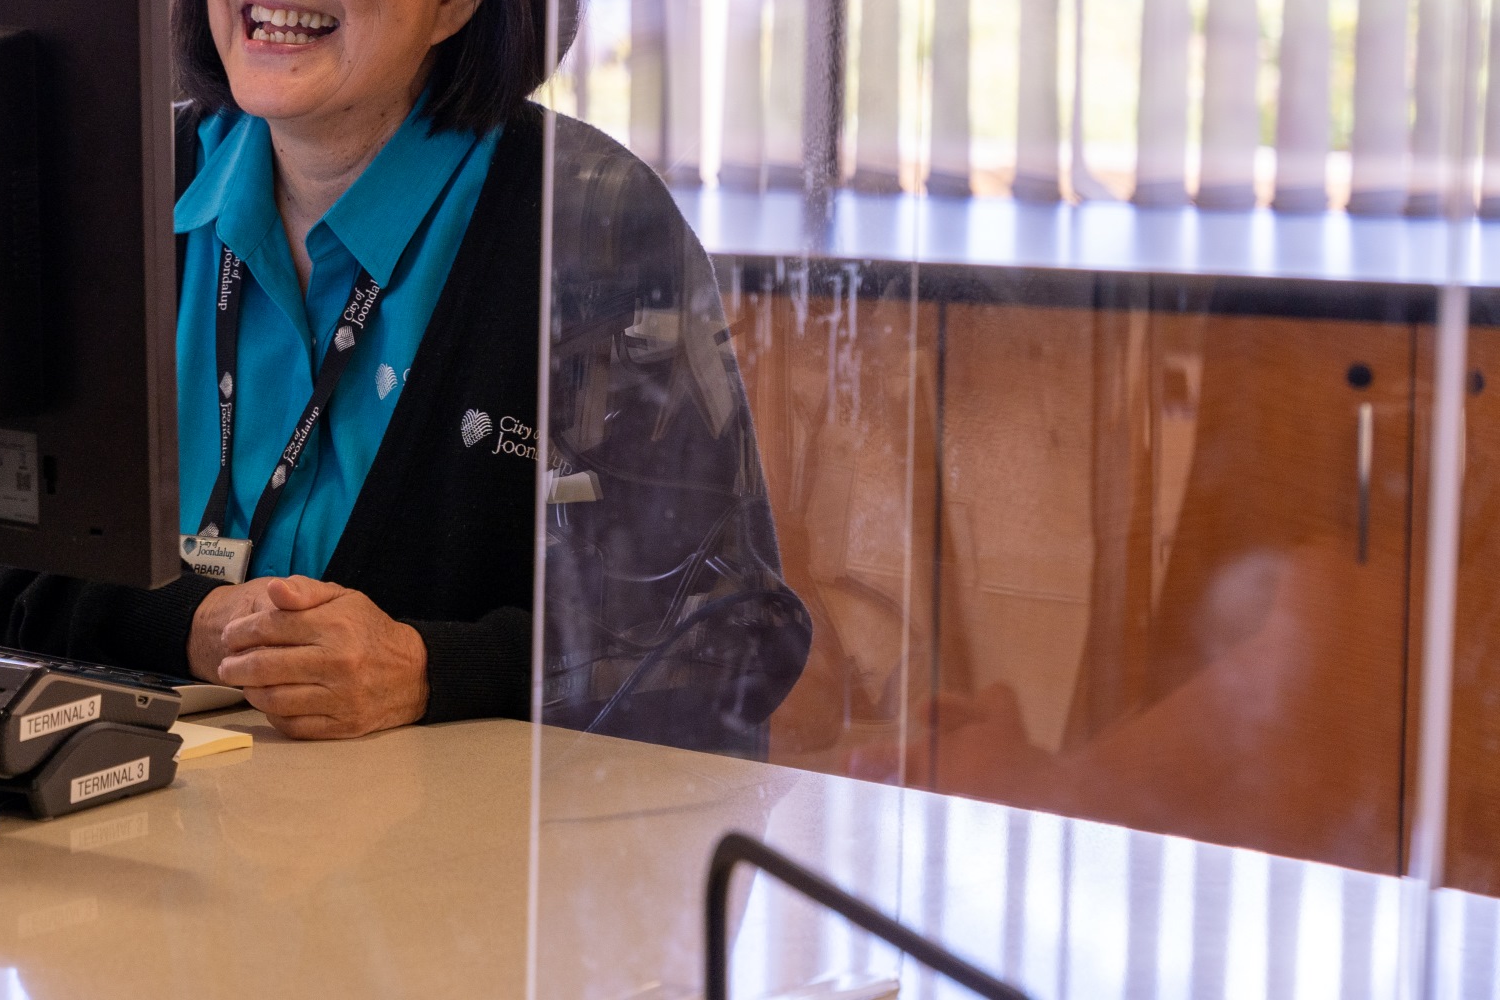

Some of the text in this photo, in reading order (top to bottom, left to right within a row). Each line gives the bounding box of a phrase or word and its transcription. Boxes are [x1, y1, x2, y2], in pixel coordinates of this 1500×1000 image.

[218, 247, 233, 311] Joondalup
[231, 269, 241, 280] of
[343, 287, 366, 321] City of
[351, 279, 380, 330] Joondal
[283, 427, 301, 460] City of
[287, 406, 320, 467] Joondalup
[500, 415, 532, 440] City
[190, 563, 225, 576] RBARA
[197, 546, 235, 560] Joondalup
[27, 700, 96, 735] TERMINAL 3
[77, 762, 145, 798] TERMINAL 3
